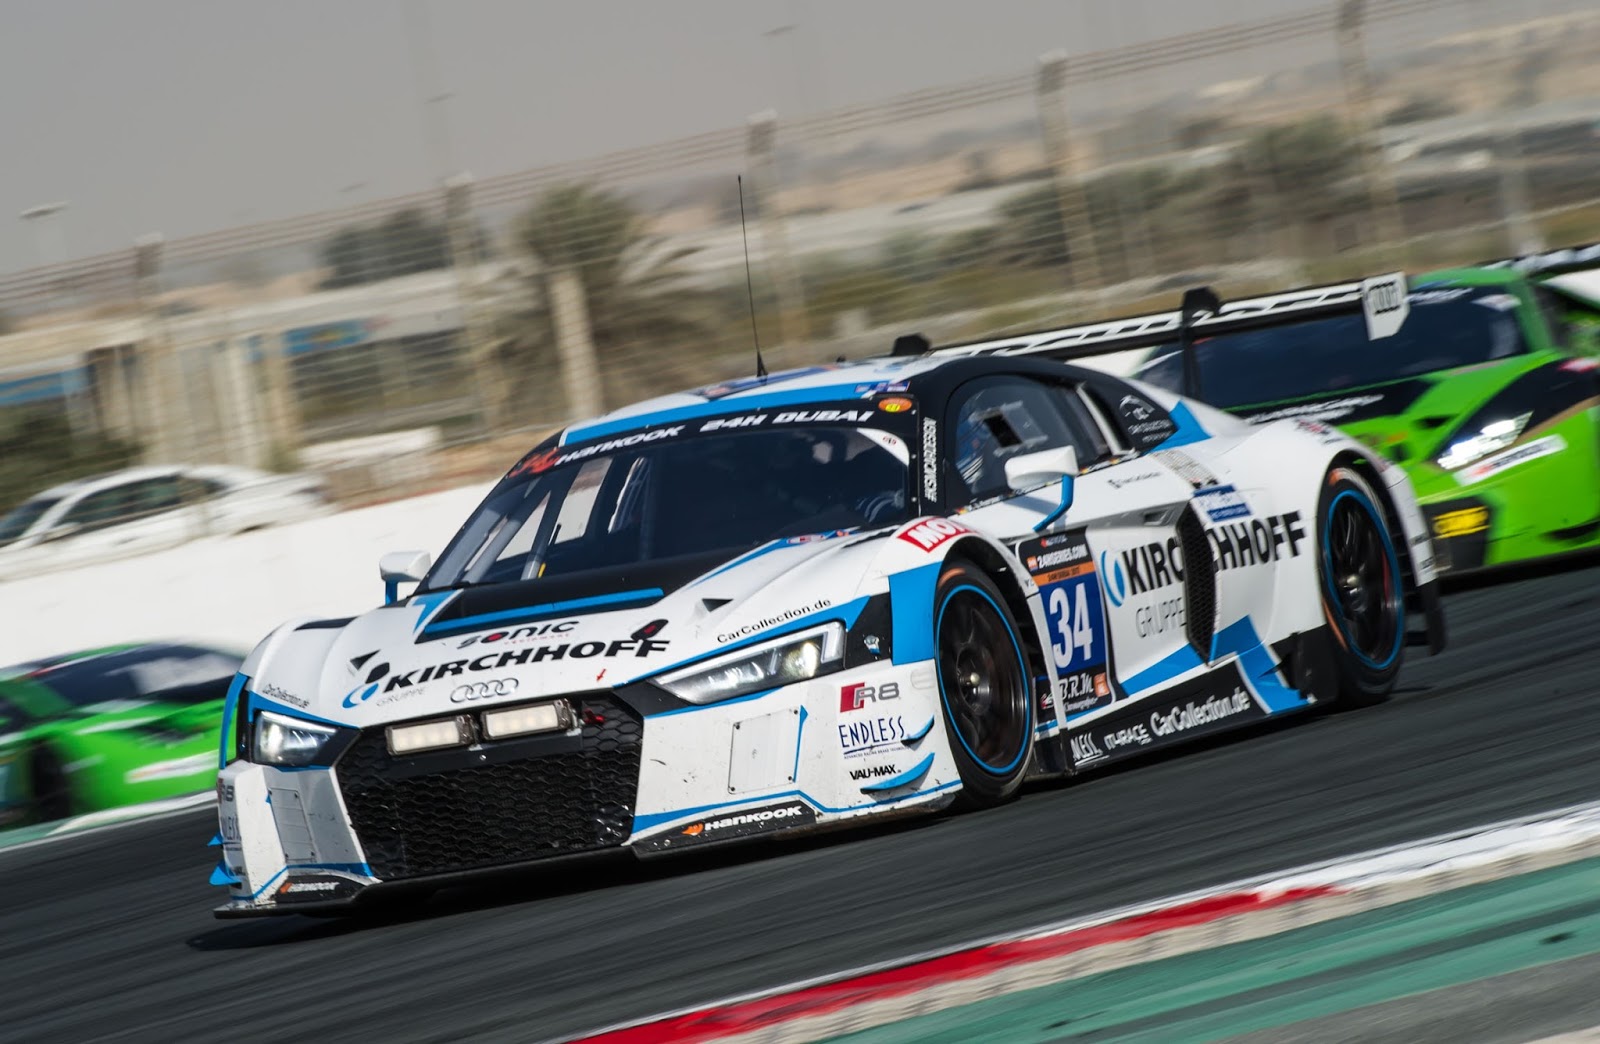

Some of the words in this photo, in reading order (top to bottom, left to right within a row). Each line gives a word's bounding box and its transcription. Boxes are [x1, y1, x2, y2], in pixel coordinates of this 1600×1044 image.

[700, 414, 768, 432] 24H
[772, 410, 875, 425] DUBAI
[717, 598, 832, 644] CarCollection.de
[1049, 582, 1093, 668] 34
[382, 640, 670, 693] KIRCHHOFF
[853, 682, 900, 708] R8
[1151, 687, 1251, 736] CarCollection.de
[838, 716, 905, 748] ENDLESS
[850, 764, 896, 781] VAU-MAX
